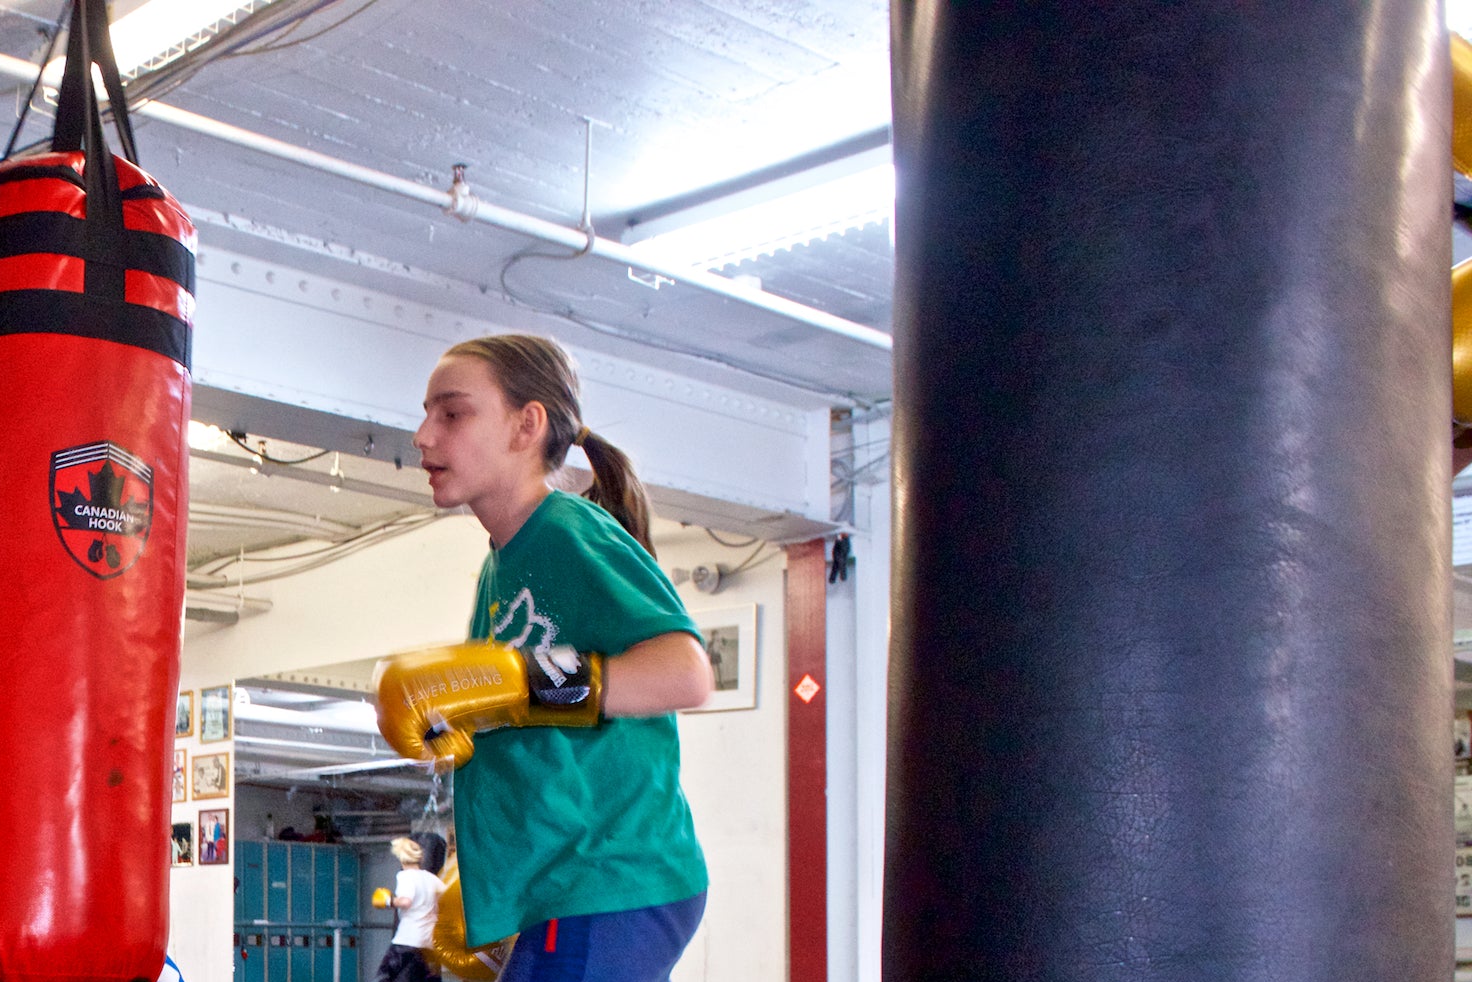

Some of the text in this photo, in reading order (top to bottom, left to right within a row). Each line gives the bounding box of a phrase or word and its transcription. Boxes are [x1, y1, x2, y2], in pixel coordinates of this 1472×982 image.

[74, 505, 134, 523] CANADIAN
[89, 518, 122, 532] HOOK
[403, 673, 503, 709] EAVER BOXING
